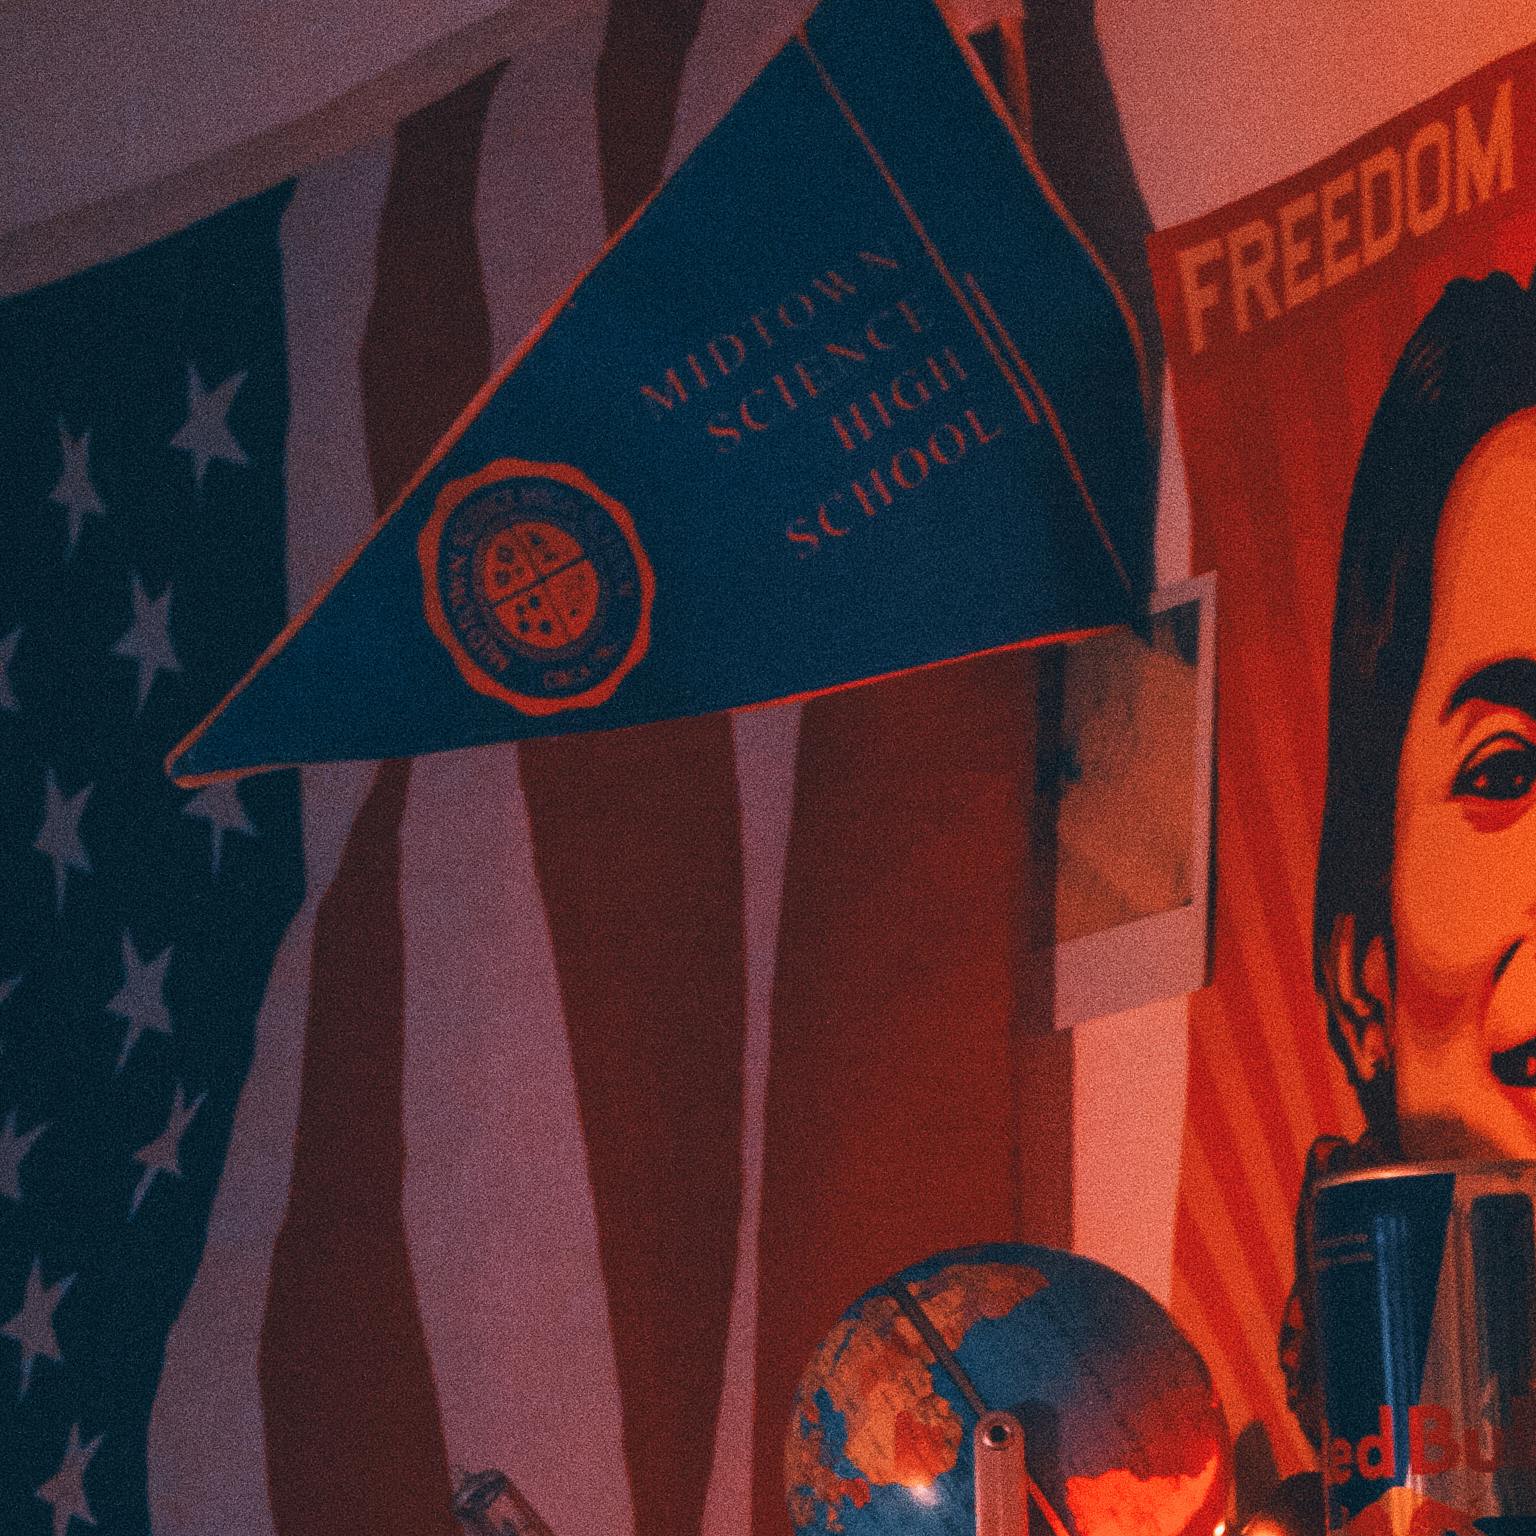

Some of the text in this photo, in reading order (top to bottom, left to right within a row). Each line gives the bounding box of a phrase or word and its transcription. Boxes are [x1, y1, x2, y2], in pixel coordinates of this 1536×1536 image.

[1175, 82, 1515, 356] FREEDOM
[639, 240, 903, 423] MIDTOWN
[706, 294, 936, 454] SCIENCE
[832, 345, 969, 453] HIGH
[785, 408, 1005, 560] SCHOOL
